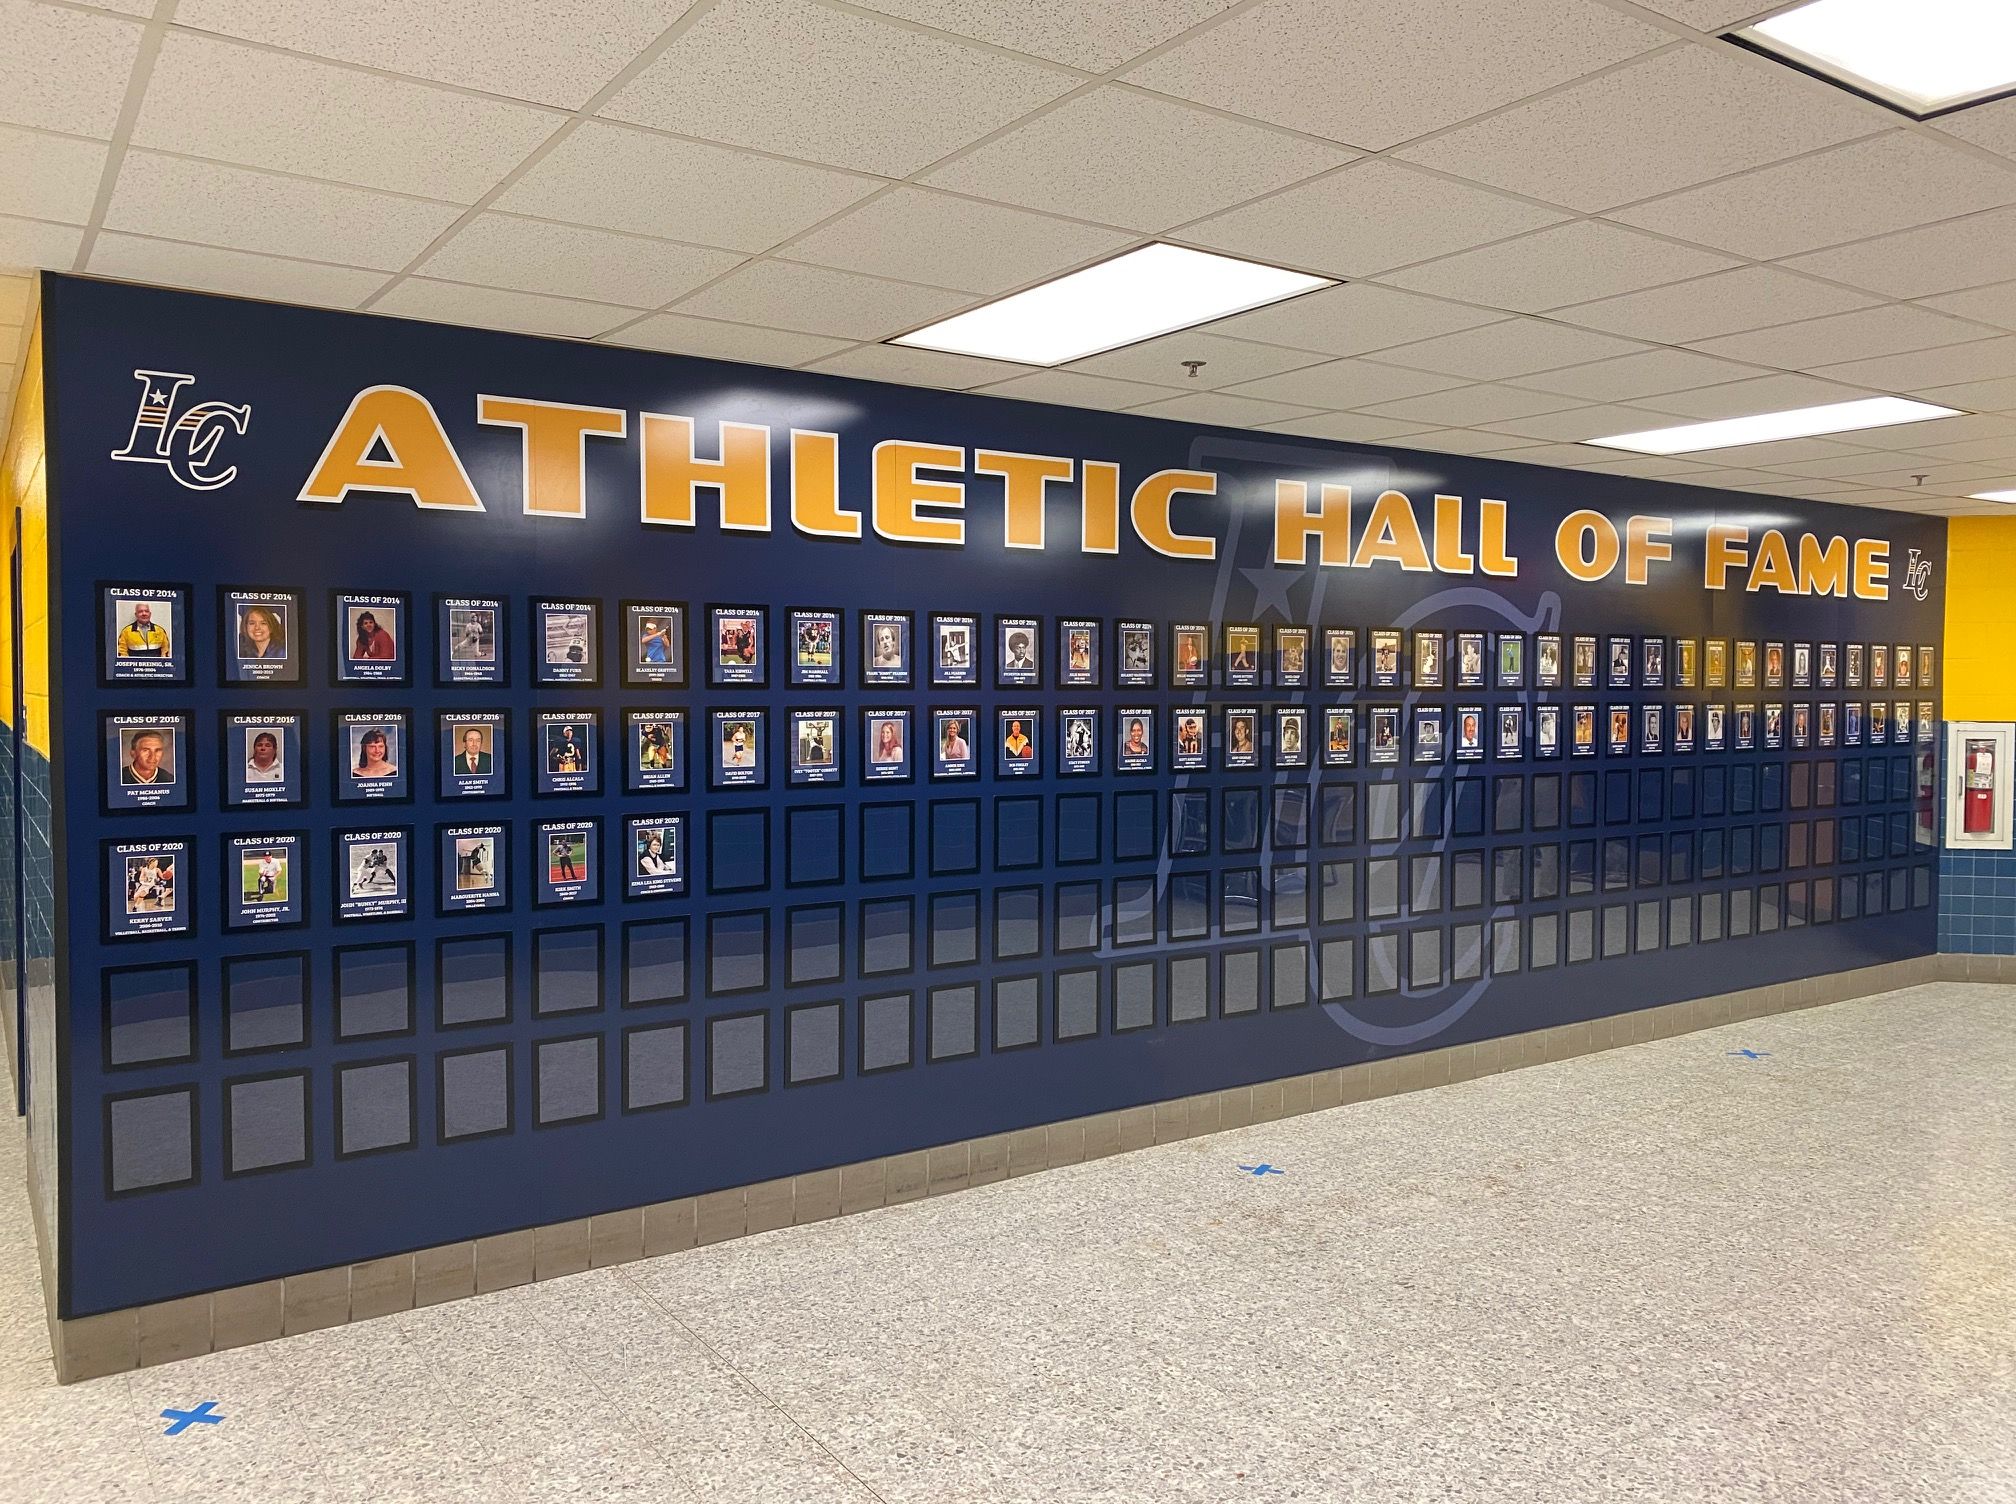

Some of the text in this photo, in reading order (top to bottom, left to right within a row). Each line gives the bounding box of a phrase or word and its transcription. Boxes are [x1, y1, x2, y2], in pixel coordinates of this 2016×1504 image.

[296, 384, 1890, 601] ATHLETIC HALL OF FAME
[110, 588, 140, 596] CLASS
[156, 590, 176, 598] 2014
[231, 592, 258, 600] CLASS
[542, 823, 565, 831] CLASS
[448, 828, 472, 836] CLASS
[234, 836, 295, 846] CLASS OF 2020
[345, 833, 370, 841] CLASS
[117, 843, 183, 853] CLASS OF 2020
